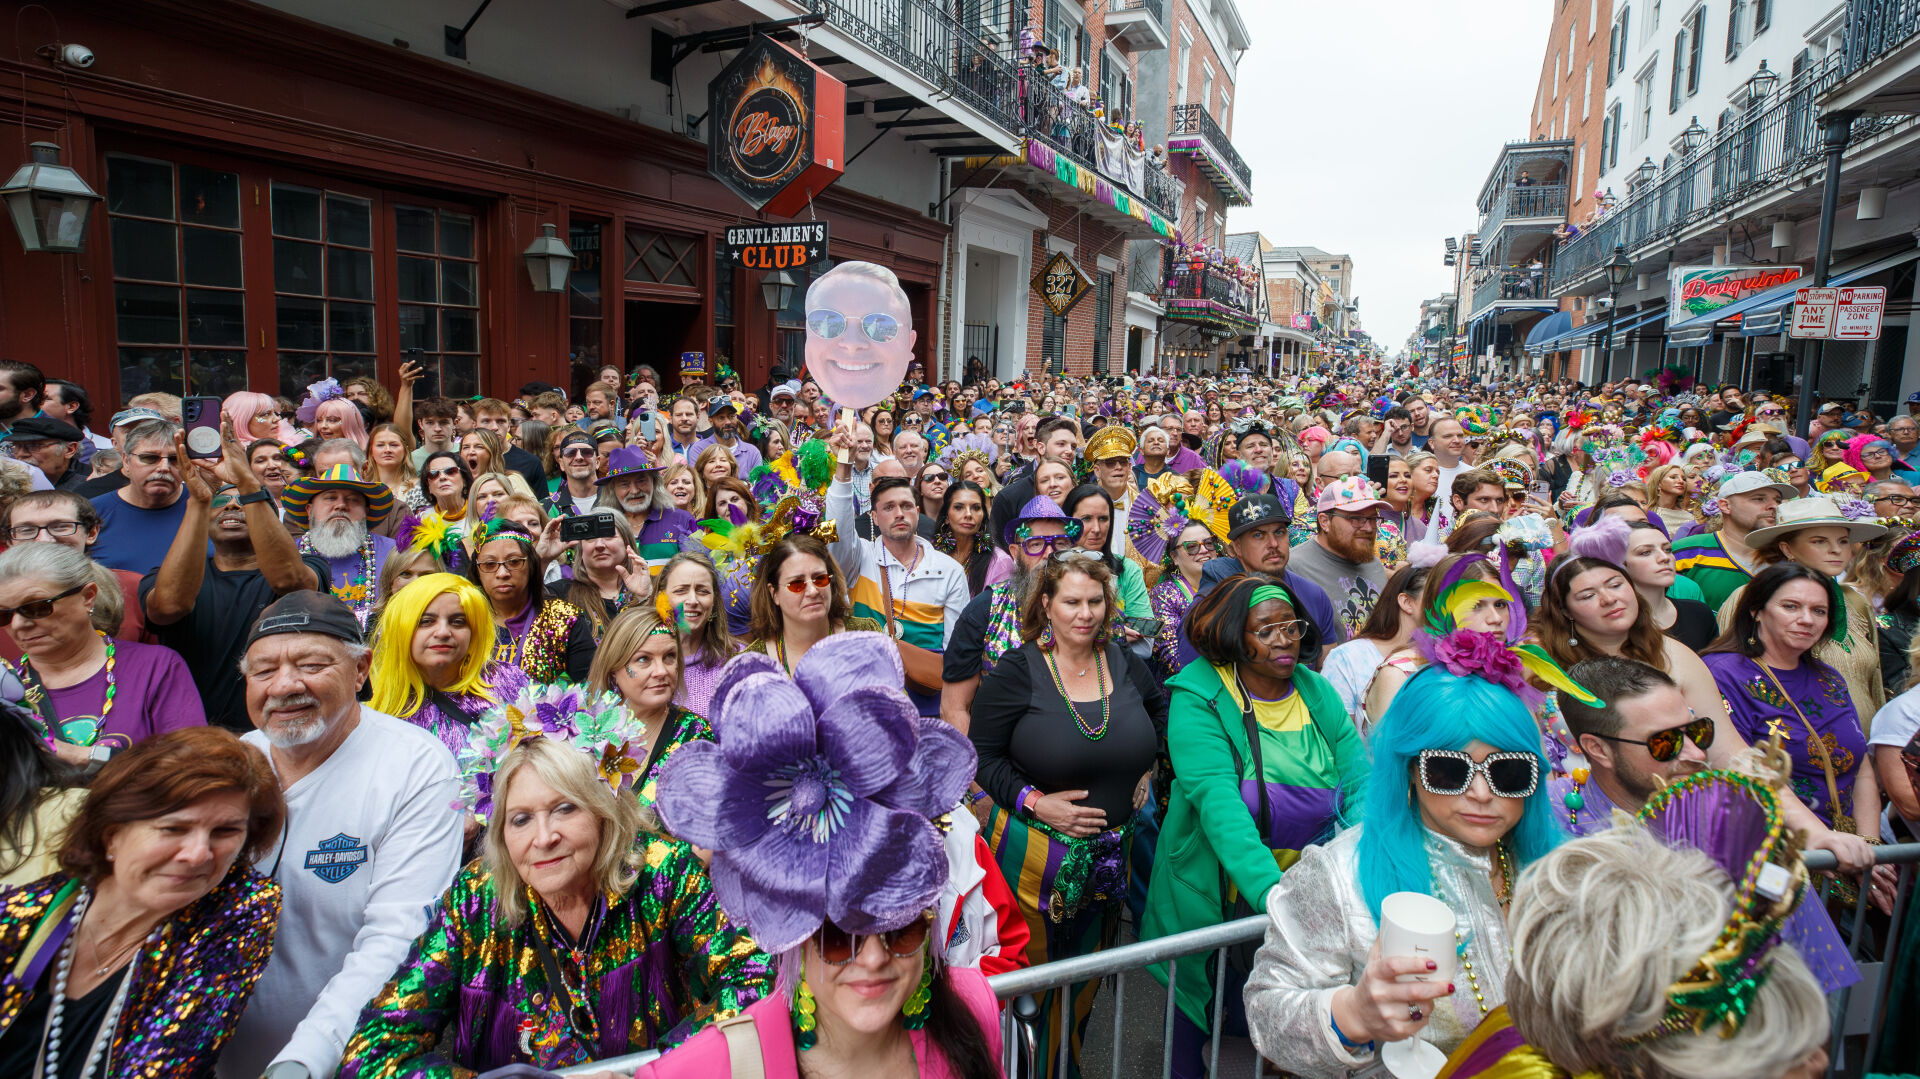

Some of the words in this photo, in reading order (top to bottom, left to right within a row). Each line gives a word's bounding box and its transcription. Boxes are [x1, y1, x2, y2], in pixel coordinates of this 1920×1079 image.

[728, 224, 824, 245] GENTLEMEN'S
[742, 245, 807, 268] CLUB
[1045, 275, 1076, 293] 327
[1796, 292, 1808, 302] NO
[1840, 291, 1853, 302] NO
[1853, 292, 1882, 300] PARKING
[1802, 306, 1826, 314] ANY
[1840, 305, 1879, 313] PASSENGER
[1801, 315, 1825, 323] TIME
[324, 838, 355, 850] MOTOR
[309, 850, 365, 865] HARLEY-DAVIDSON
[320, 865, 352, 879] CYCLES
